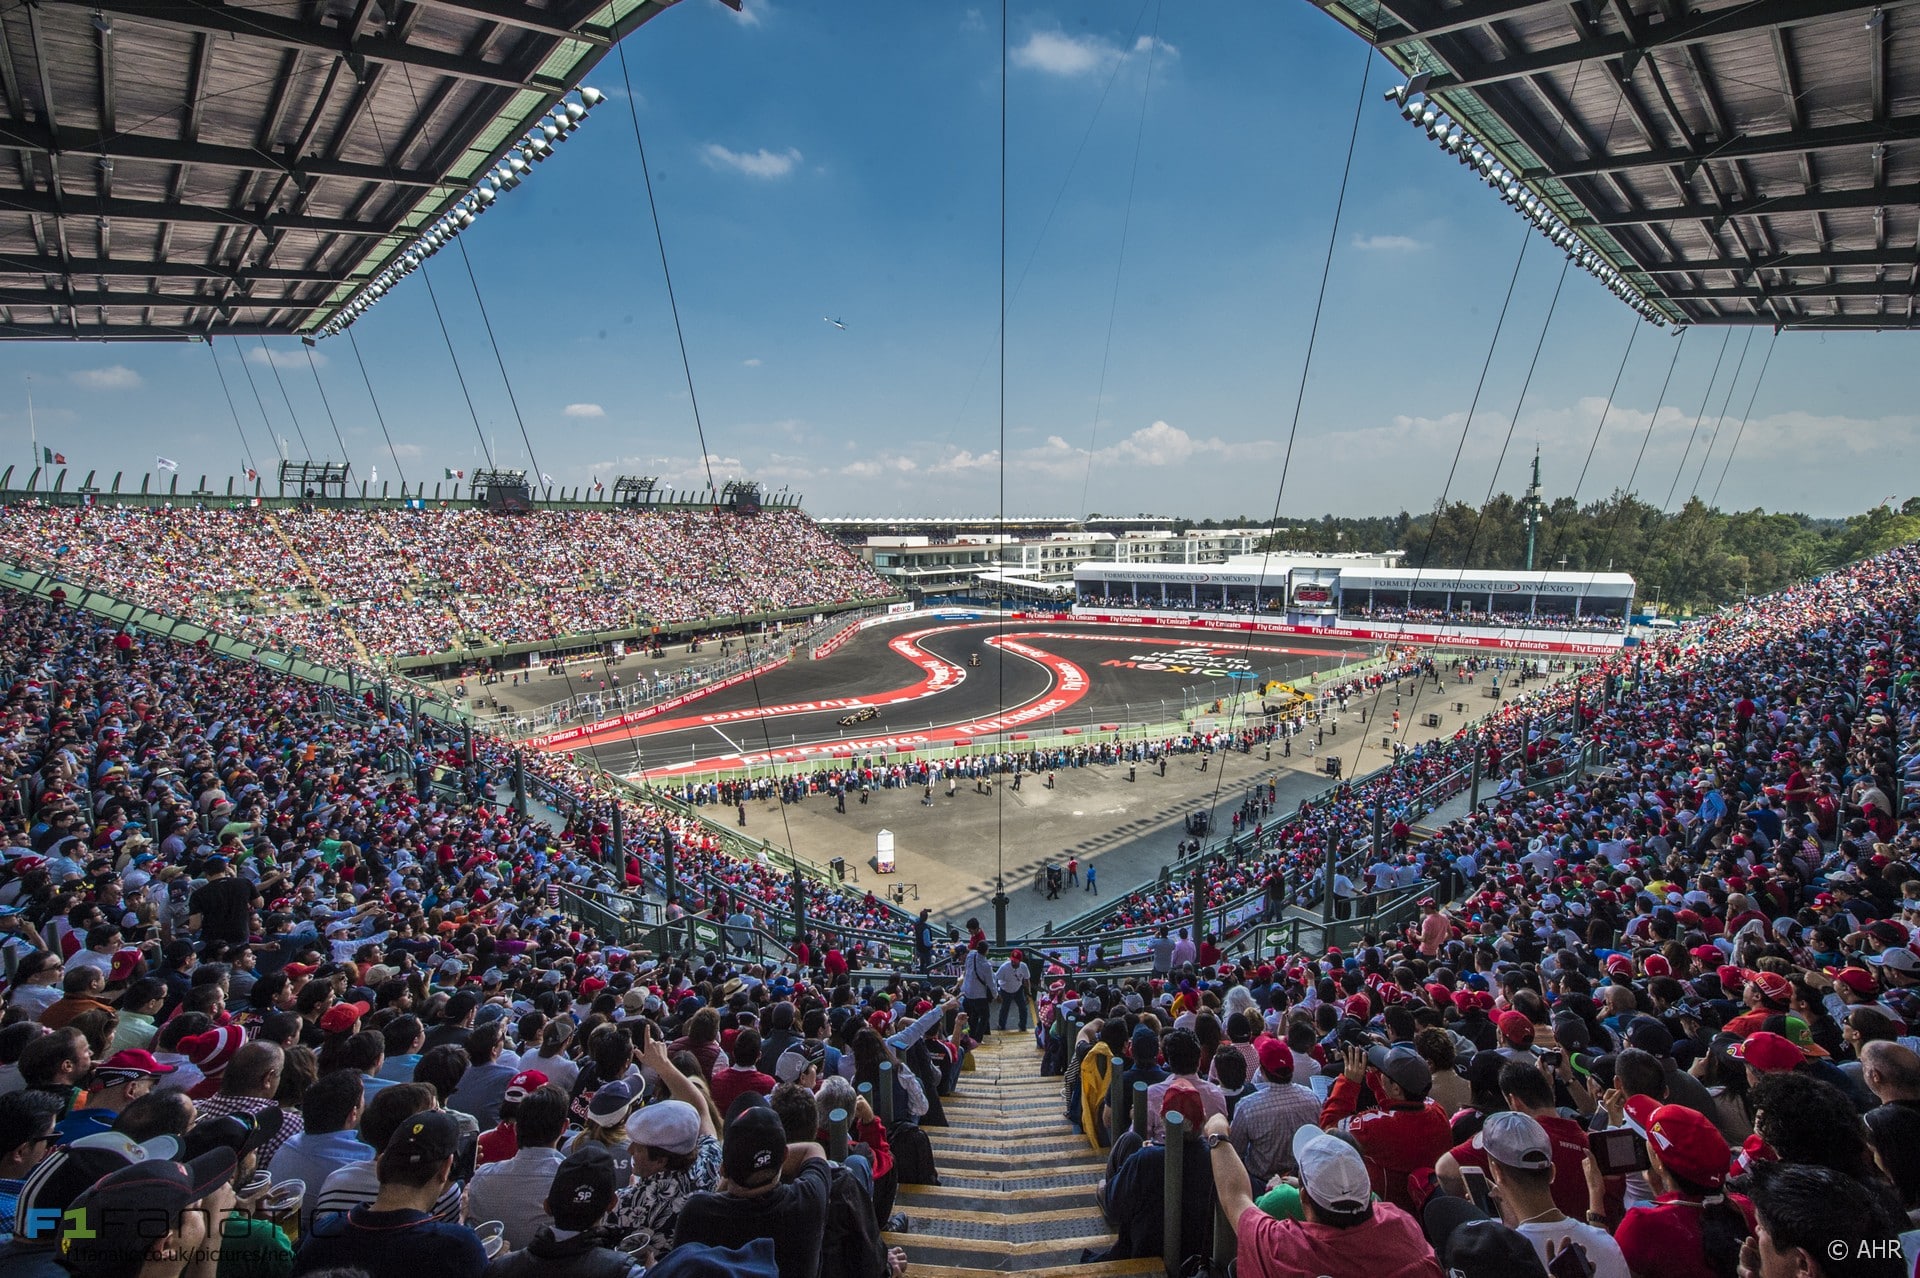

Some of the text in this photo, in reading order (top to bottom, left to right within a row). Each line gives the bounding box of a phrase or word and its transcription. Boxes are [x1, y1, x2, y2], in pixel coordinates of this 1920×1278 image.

[1374, 579, 1417, 587] FORMULA
[1441, 582, 1486, 590] PADDOCK
[1166, 618, 1191, 626] Emirates
[1205, 620, 1215, 628] Fly
[1257, 623, 1296, 632] Fly Emirates
[1311, 627, 1353, 636] Fly Emirates
[1370, 631, 1414, 640] Fly Emirates
[1433, 635, 1480, 645] Fly Emirates
[1500, 640, 1549, 650] Fly Emirates
[1571, 644, 1586, 653] Fly
[1151, 651, 1222, 661] HAPPY
[624, 714, 634, 723] Fly
[582, 718, 621, 735] Fly Emirates
[955, 720, 1004, 734] Fly
[533, 737, 548, 746] Fly
[548, 730, 579, 743] Emirates
[800, 734, 929, 754] Emirates
